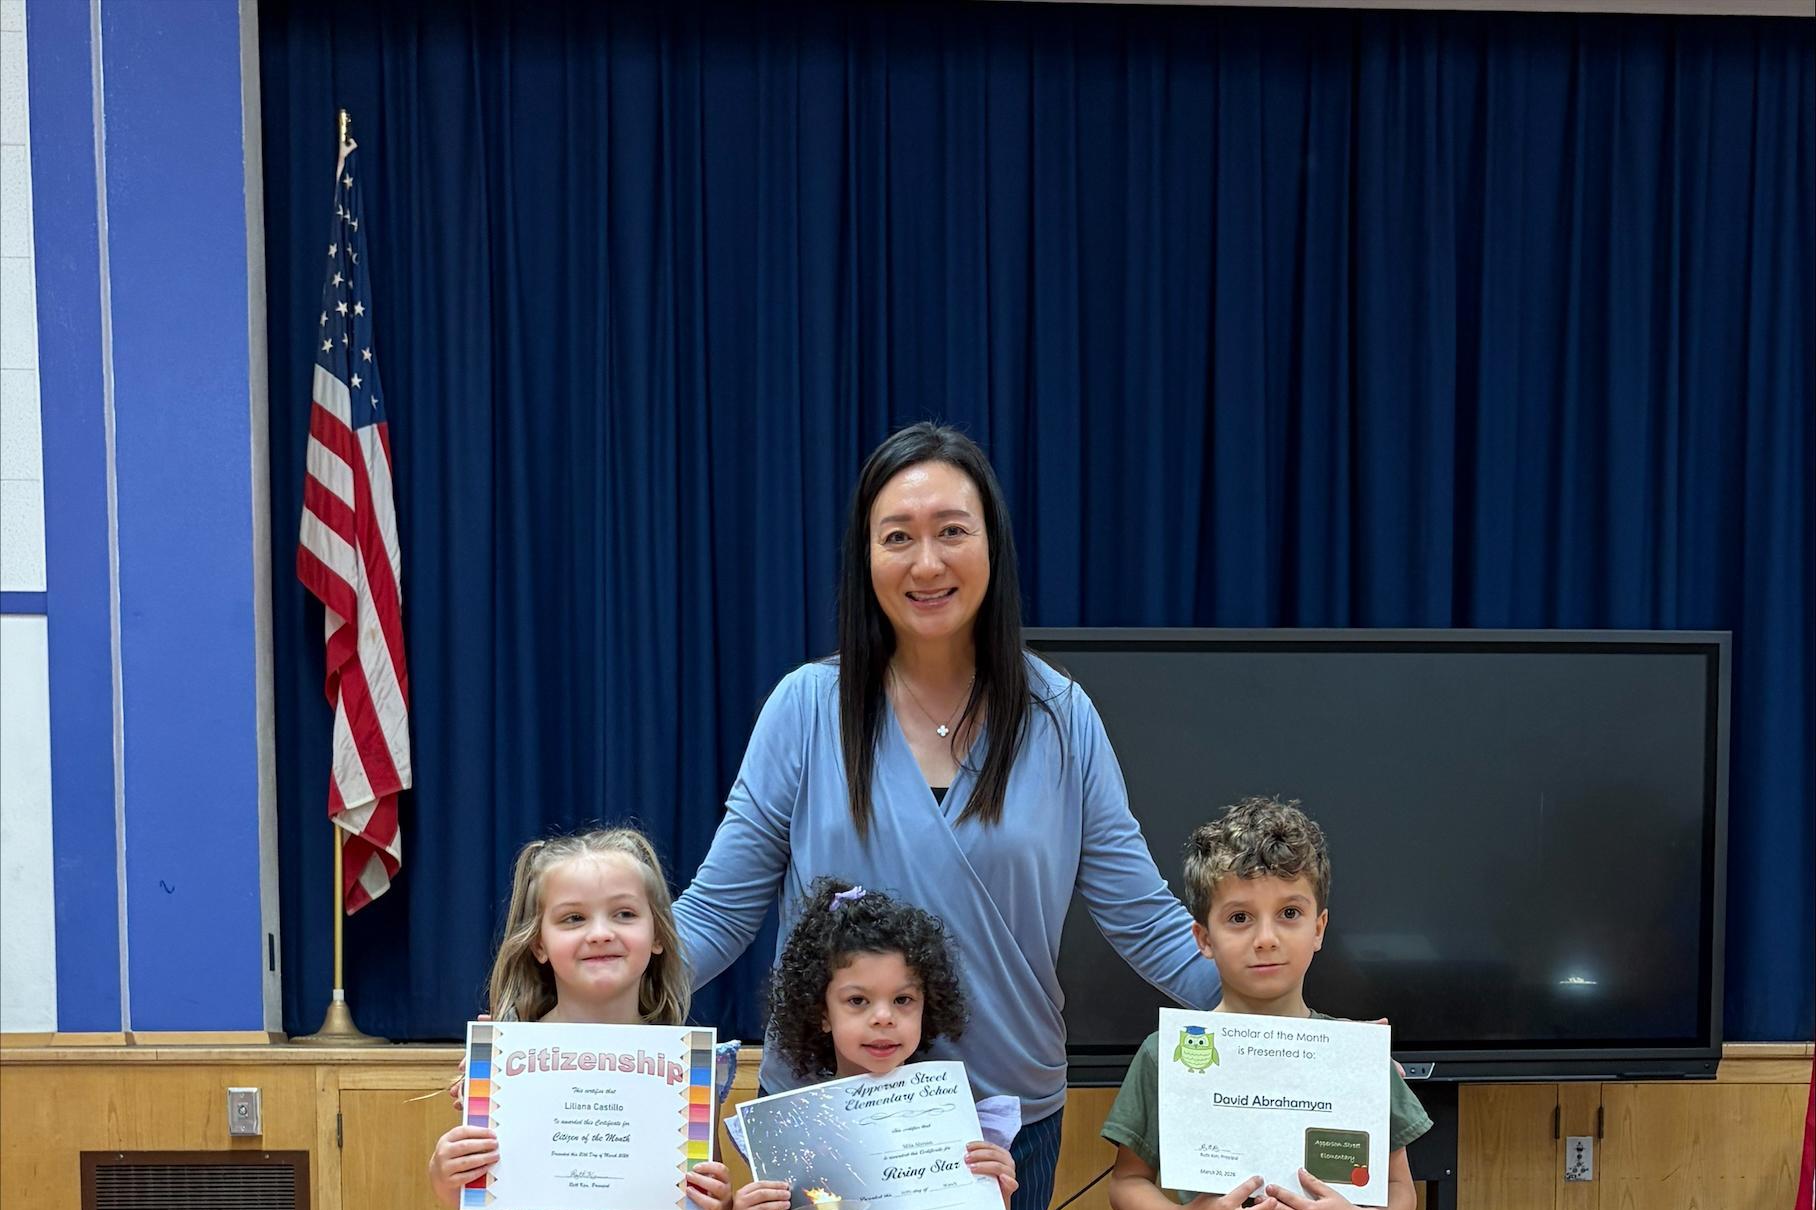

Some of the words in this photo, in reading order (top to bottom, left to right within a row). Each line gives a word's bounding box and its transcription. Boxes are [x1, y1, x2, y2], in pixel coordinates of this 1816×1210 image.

[1222, 1027, 1260, 1039] Scholar
[1263, 1030, 1274, 1039] of
[1277, 1031, 1294, 1041] the
[1296, 1033, 1330, 1043] Month
[1238, 1046, 1244, 1055] is
[1247, 1046, 1300, 1058] Presented
[1303, 1050, 1316, 1060] to:
[505, 1047, 684, 1086] Citizenship
[845, 1080, 905, 1098] Apperson
[910, 1072, 947, 1085] Street
[845, 1092, 915, 1111] Elementary
[919, 1085, 958, 1097] School
[1213, 1092, 1249, 1106] David
[1252, 1095, 1332, 1111] Abrahamyan
[565, 1102, 591, 1110] Liliana
[593, 1103, 624, 1111] Castillo
[552, 1132, 579, 1143] Citizen
[581, 1133, 590, 1144] of
[592, 1133, 603, 1142] the
[605, 1134, 631, 1142] Month
[1315, 1140, 1342, 1148] Apperson
[1320, 1152, 1355, 1164] Elementary
[881, 1166, 926, 1181] Rising
[930, 1159, 960, 1173] Star
